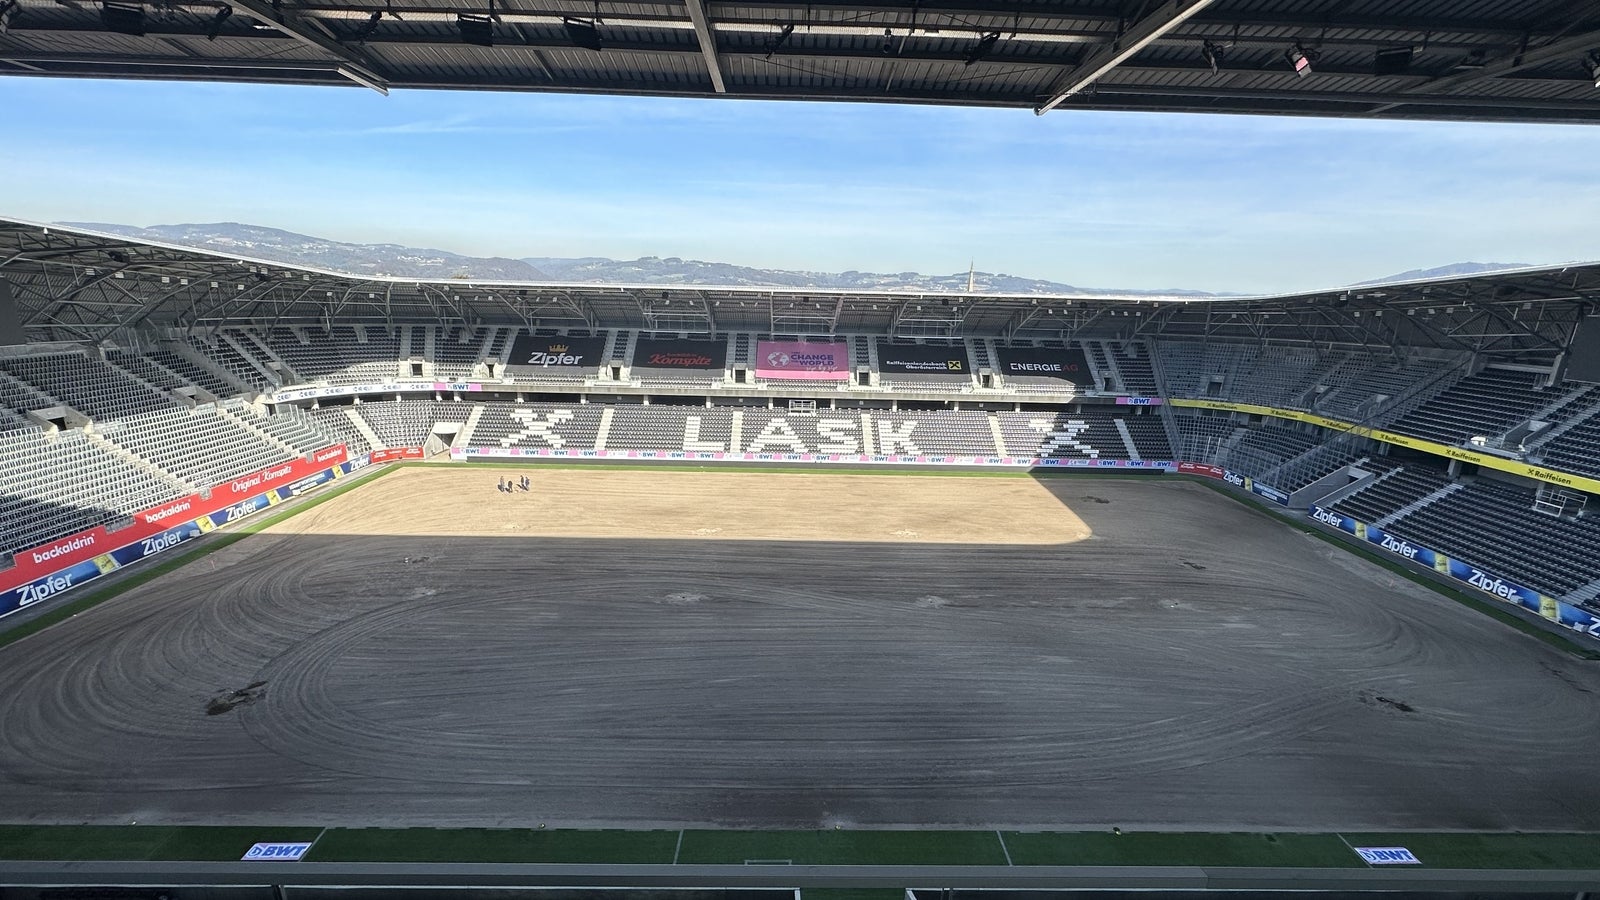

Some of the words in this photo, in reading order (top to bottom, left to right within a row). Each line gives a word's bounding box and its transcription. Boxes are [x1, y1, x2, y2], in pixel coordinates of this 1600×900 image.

[528, 352, 583, 367] Zipfer
[1010, 363, 1062, 372] ENERGIE
[1062, 364, 1079, 372] AG
[682, 415, 922, 455] LASK
[350, 456, 370, 471] Zipfer
[1451, 450, 1481, 463] Raiffeisen
[231, 475, 261, 493] Original
[262, 466, 292, 482] Kornspitz
[1223, 470, 1243, 486] Zipfer
[1534, 470, 1572, 485] Raiffeisen
[145, 502, 190, 523] backaldrin
[225, 501, 257, 521] Zipfer
[1312, 506, 1342, 528] Zipfer
[32, 536, 94, 564] backaldrin
[141, 530, 182, 556] Zipfer
[1380, 533, 1418, 560] Zipfer
[16, 573, 72, 606] Zipfer
[1467, 569, 1516, 601] Zipfer
[261, 846, 307, 856] BWT
[1372, 850, 1413, 861] BWT
